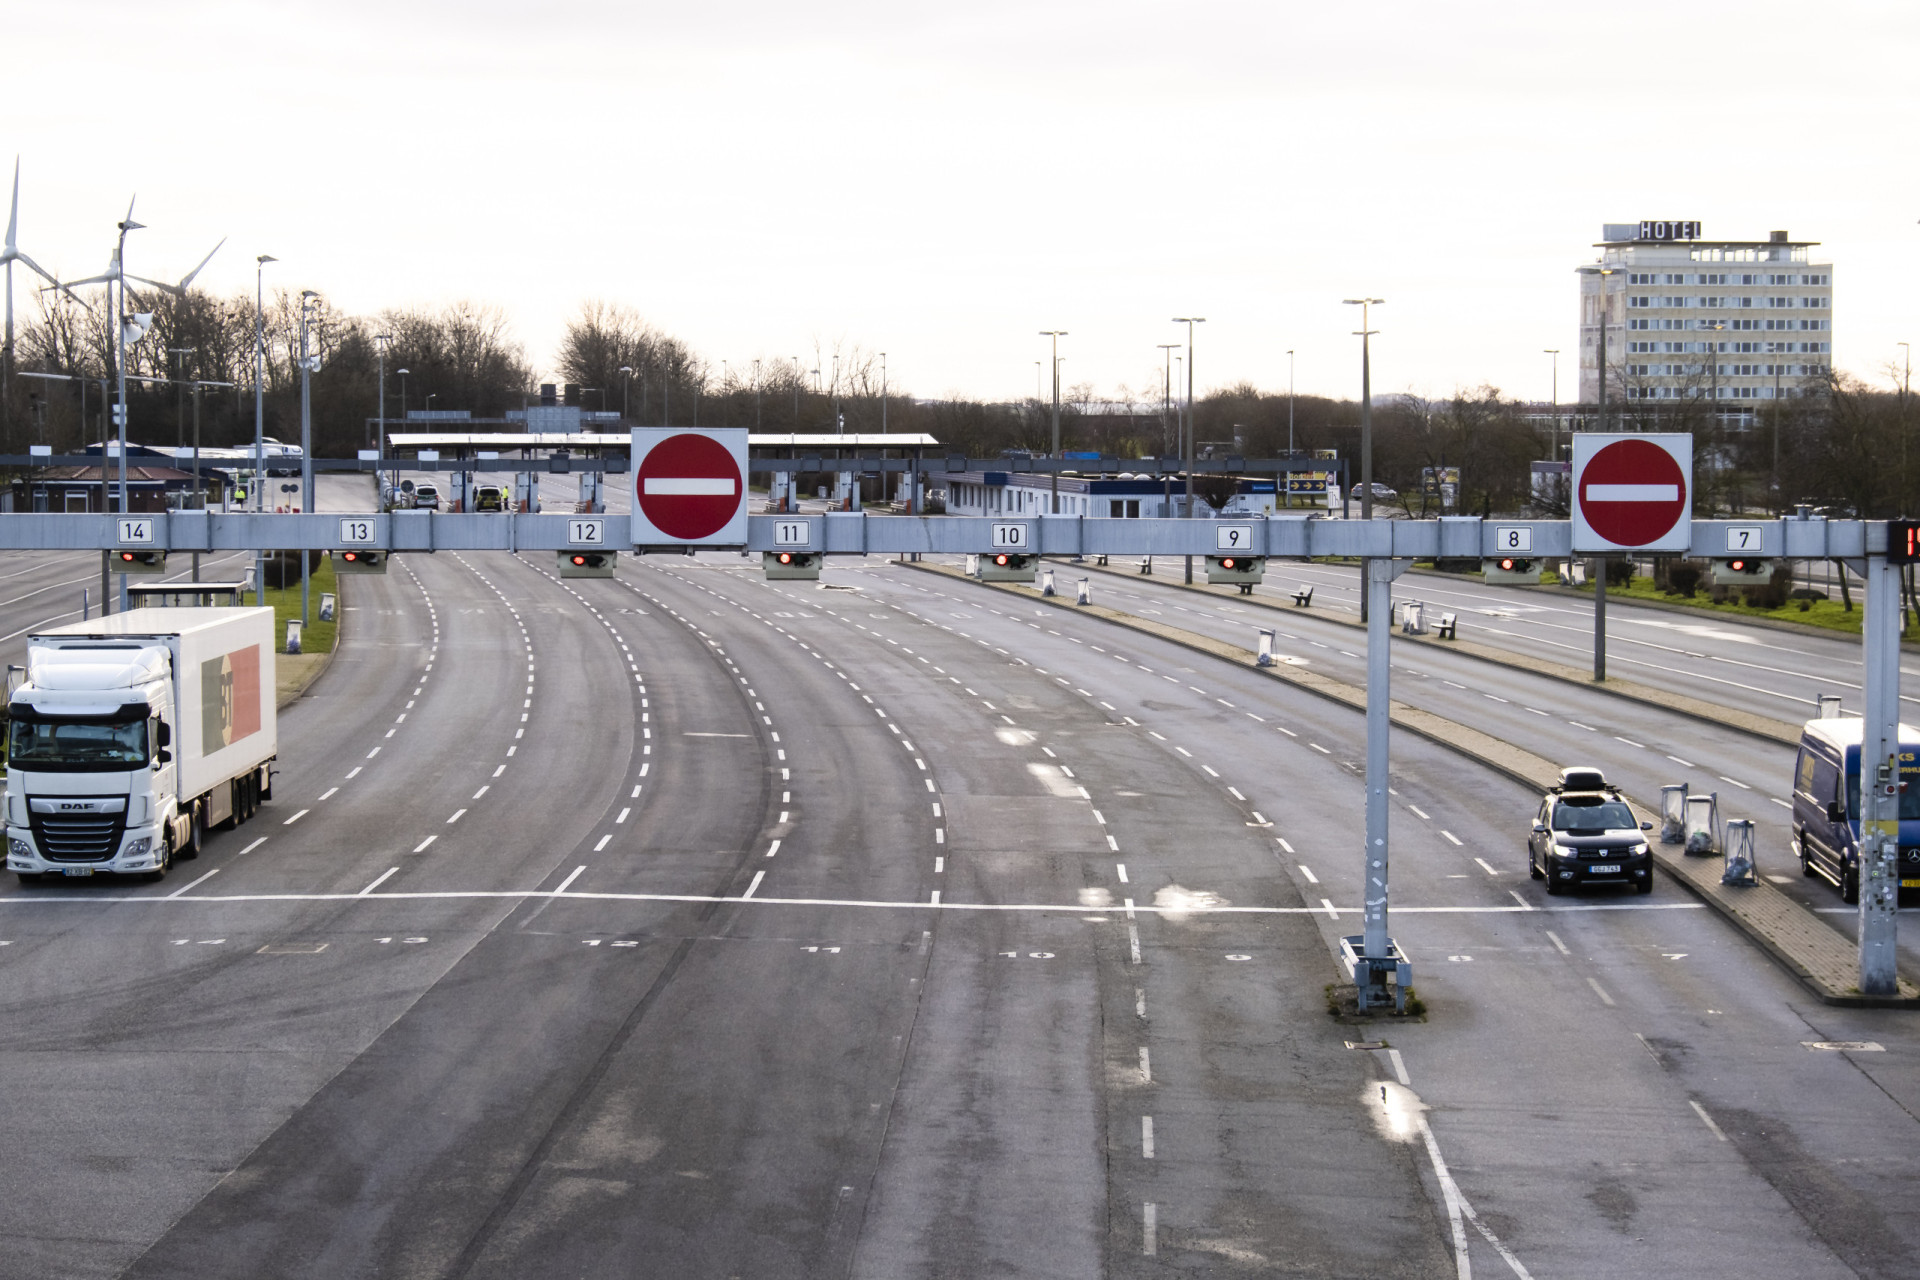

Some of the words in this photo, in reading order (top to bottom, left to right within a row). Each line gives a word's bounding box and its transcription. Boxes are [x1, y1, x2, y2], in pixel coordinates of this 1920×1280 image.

[1641, 221, 1701, 239] HOTEL
[126, 523, 144, 539] 14
[350, 524, 368, 540] 13
[577, 524, 596, 541] 12
[782, 525, 797, 542] 11
[1000, 527, 1019, 544] 10
[1229, 530, 1240, 547] 9
[1508, 531, 1519, 548] 8
[1739, 531, 1750, 548] 7
